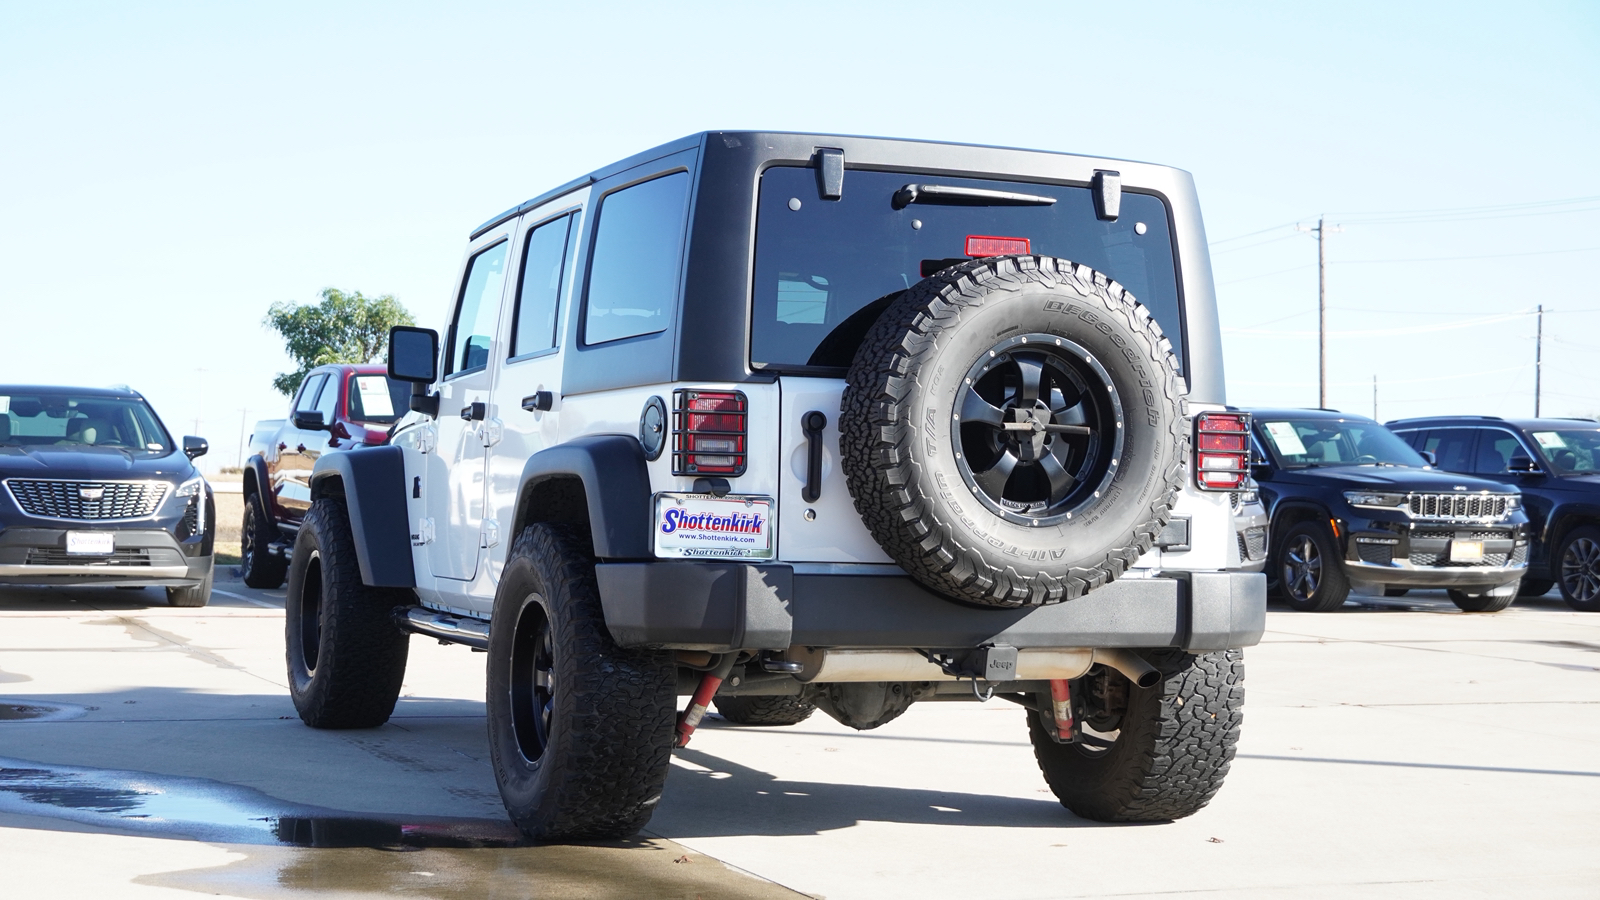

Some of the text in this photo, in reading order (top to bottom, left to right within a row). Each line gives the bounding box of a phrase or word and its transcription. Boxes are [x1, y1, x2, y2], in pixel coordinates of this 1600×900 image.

[1043, 299, 1159, 428] BFGoodrich
[926, 407, 937, 457] T/A
[661, 508, 766, 534] Shottenkirk
[934, 471, 1067, 561] All-Terrain
[70, 537, 111, 546] Shottenkirk
[679, 533, 755, 543] www.Shottenkirk.com
[683, 548, 744, 557] Shottenkirk
[989, 659, 1013, 670] Jeep
